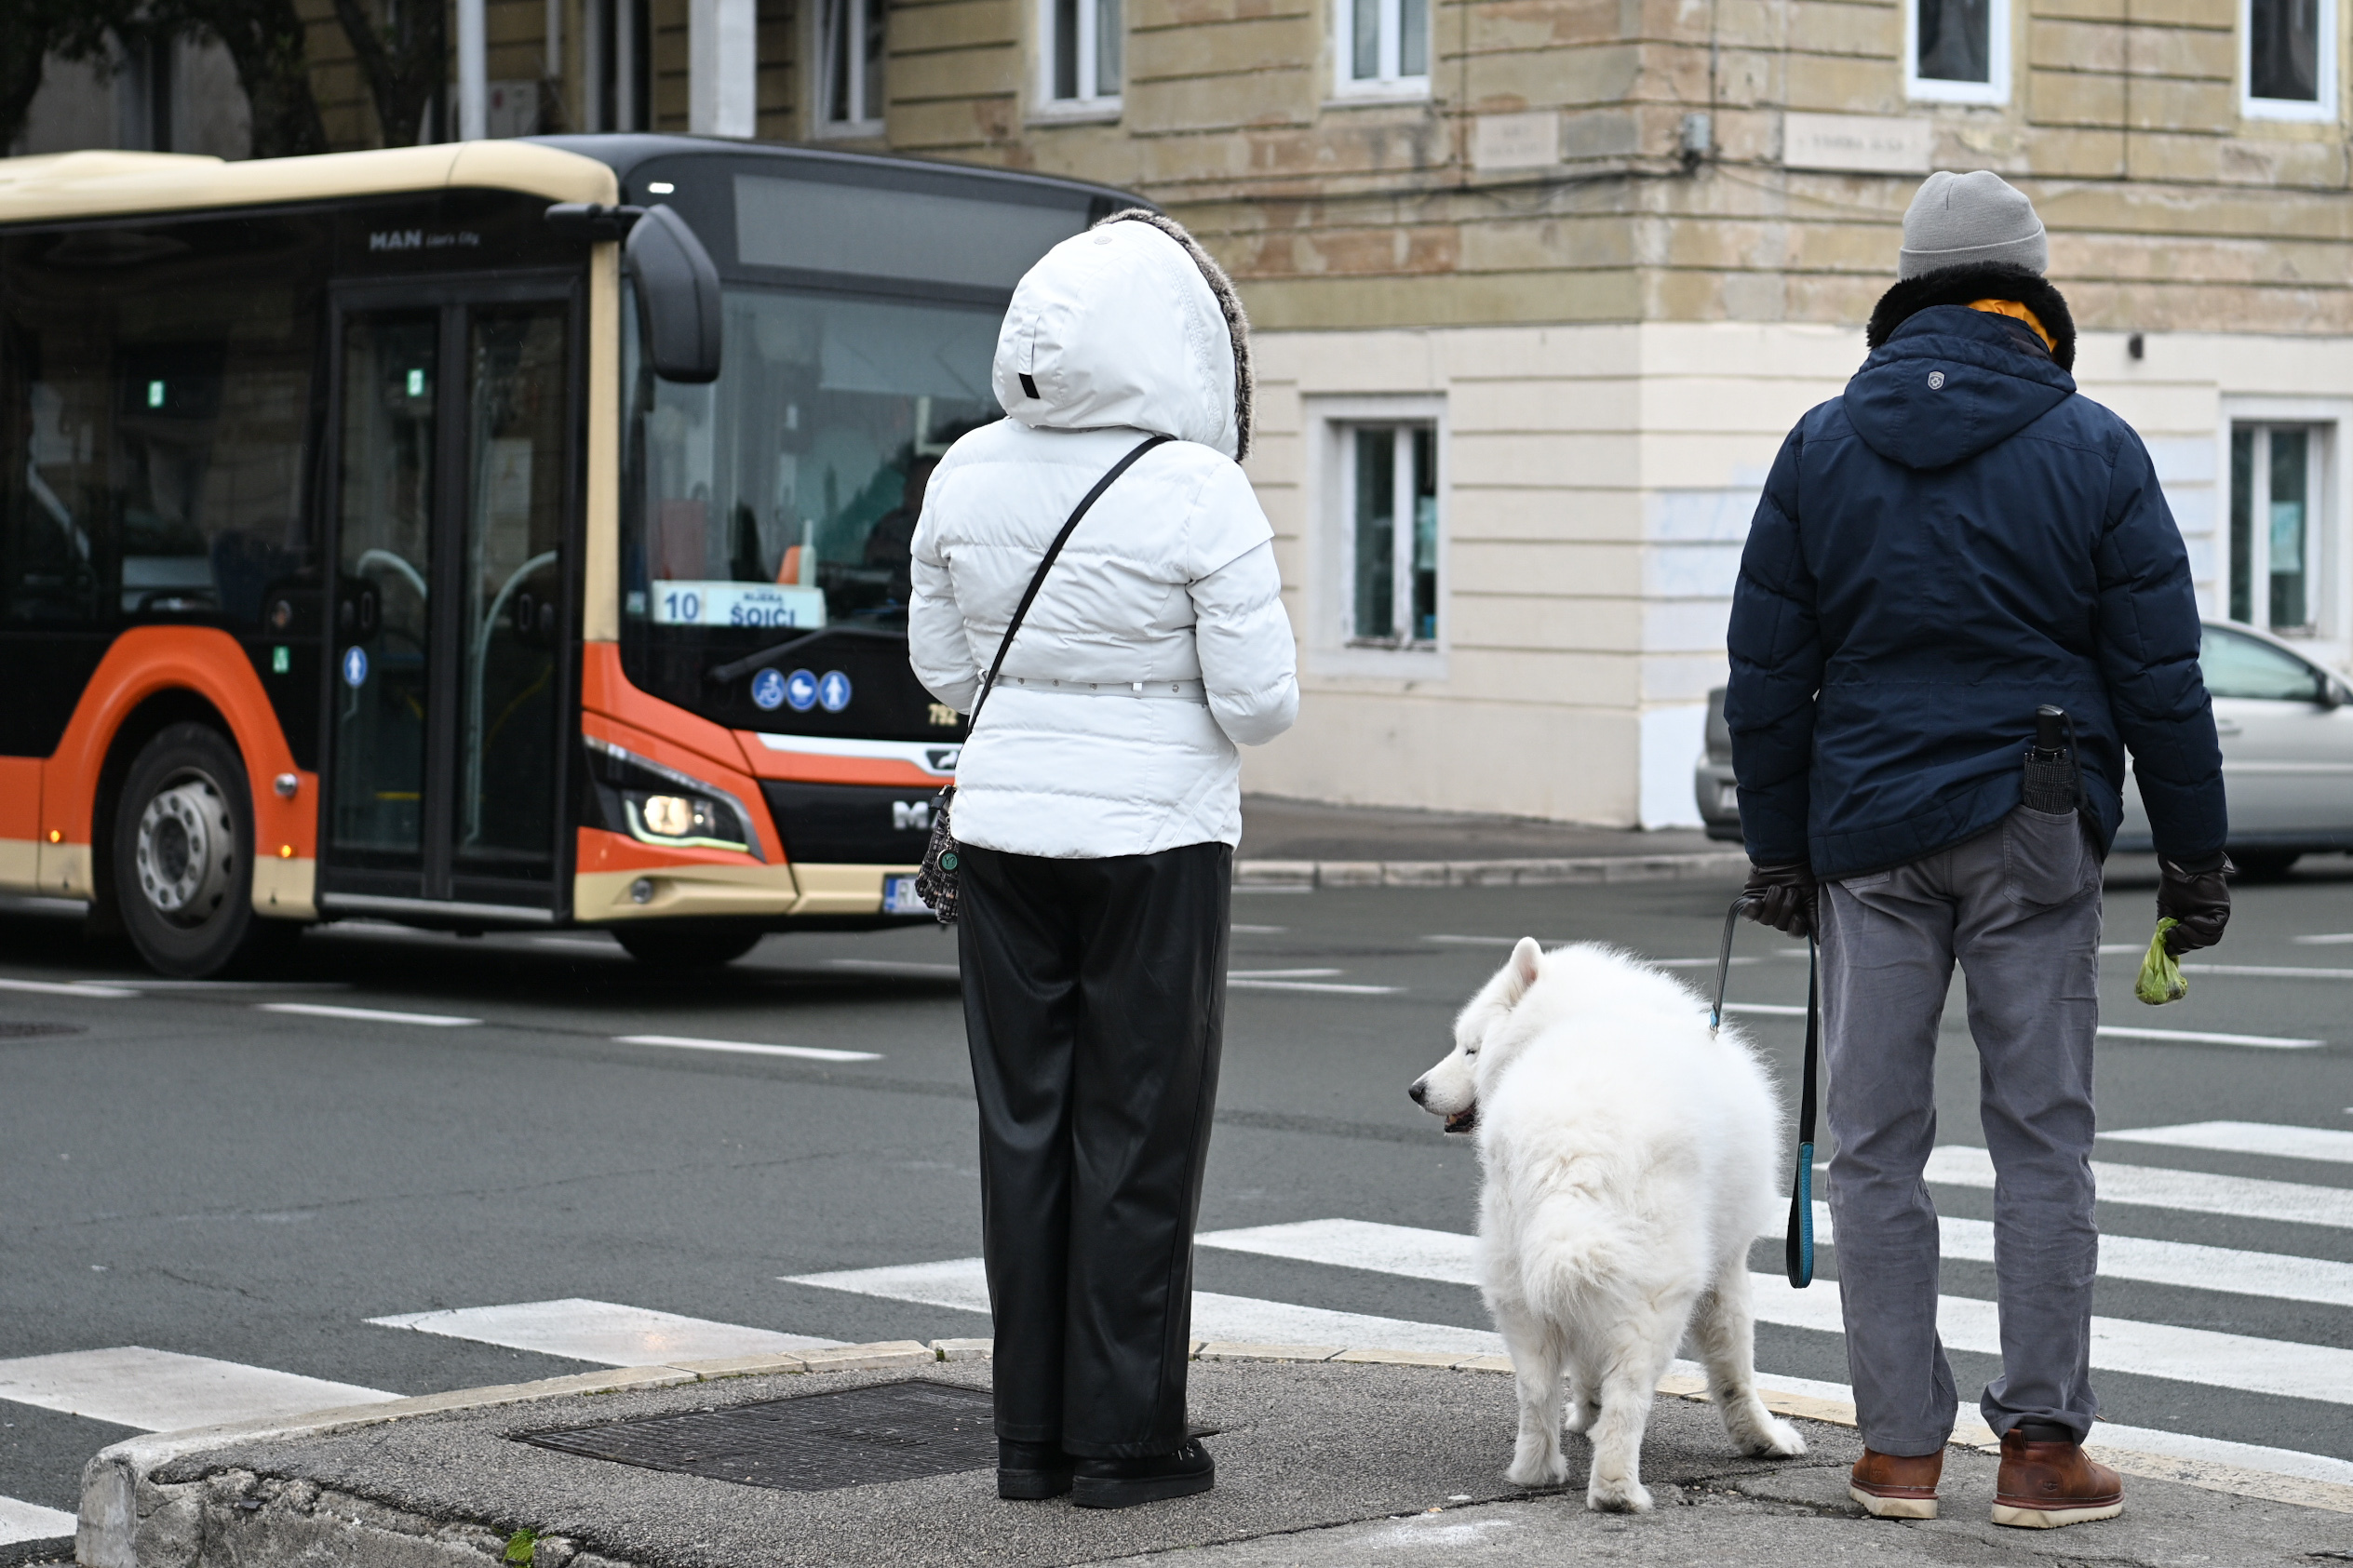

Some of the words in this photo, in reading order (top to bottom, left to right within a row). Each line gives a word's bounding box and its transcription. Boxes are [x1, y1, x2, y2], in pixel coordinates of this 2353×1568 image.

[370, 229, 423, 250] MAN
[665, 592, 700, 622] 10
[893, 800, 938, 830] M
[942, 855, 956, 866] Y?
